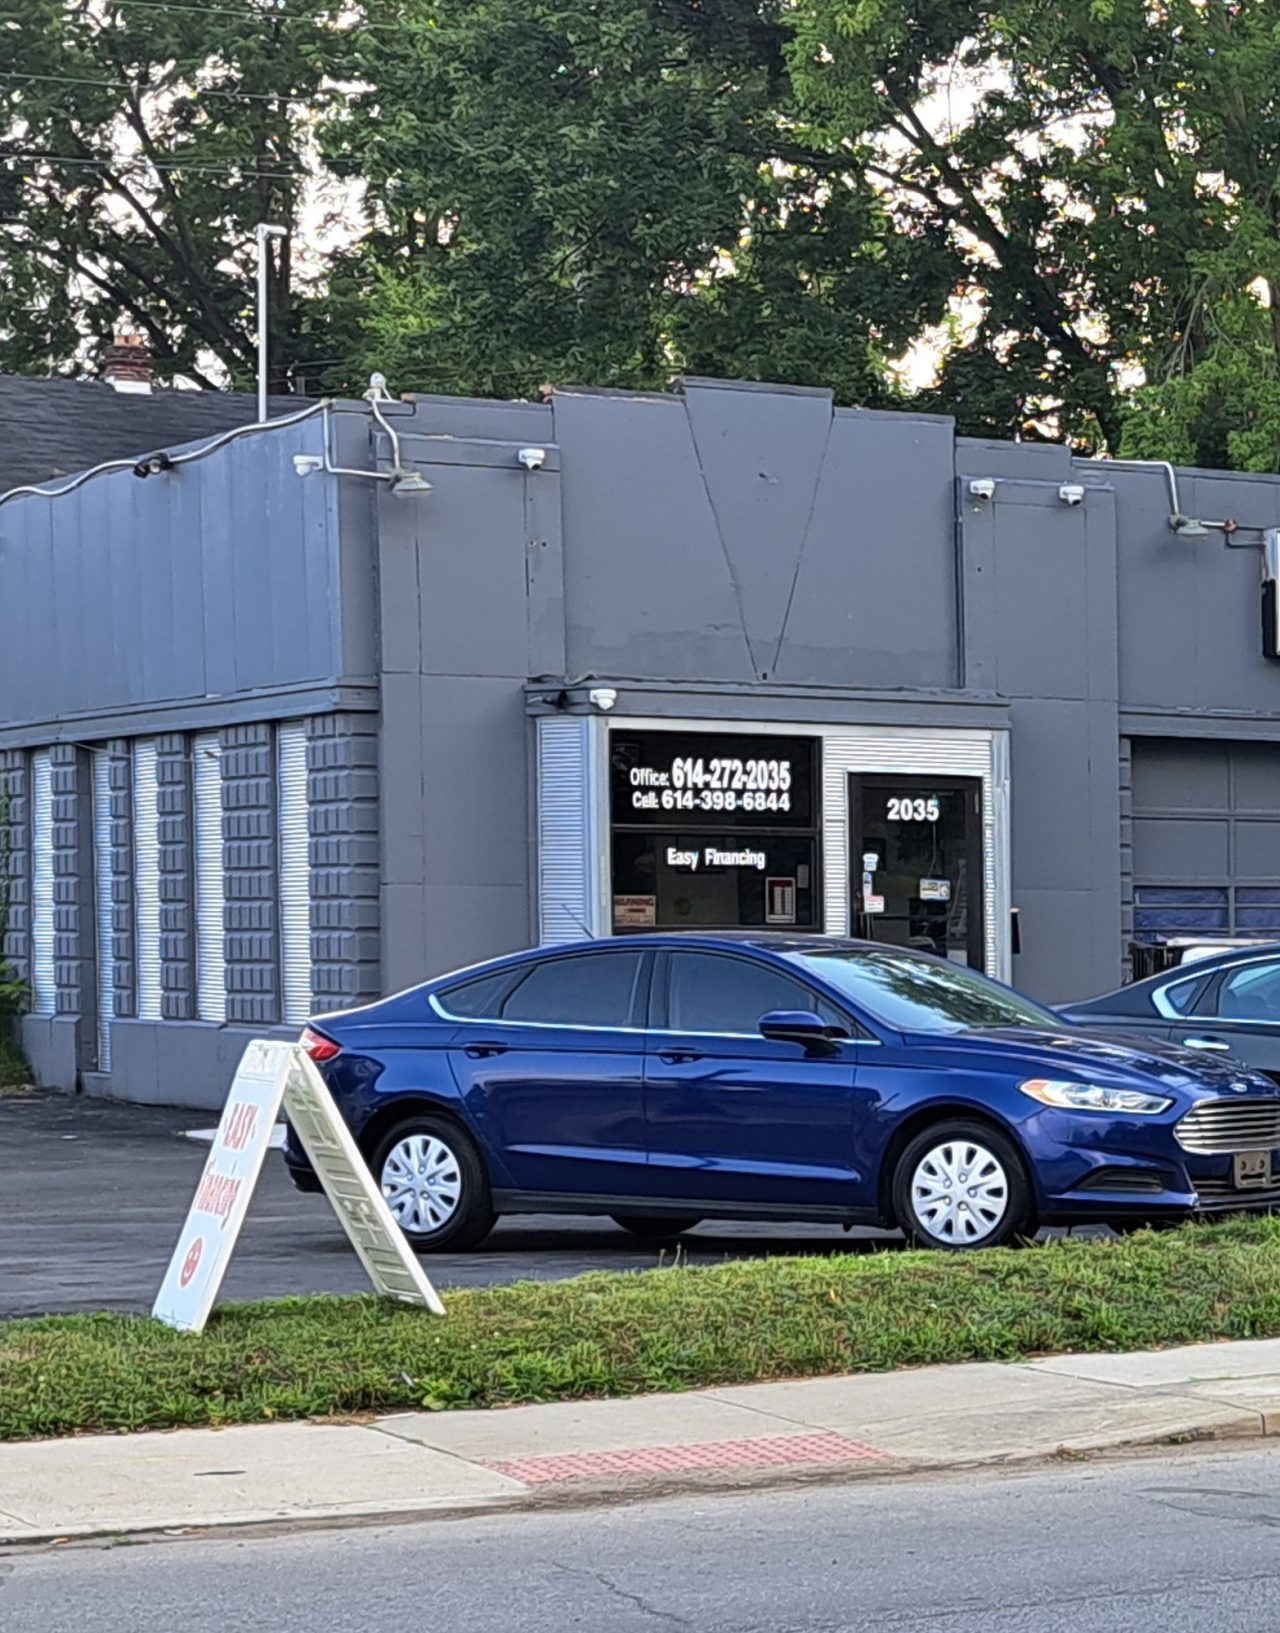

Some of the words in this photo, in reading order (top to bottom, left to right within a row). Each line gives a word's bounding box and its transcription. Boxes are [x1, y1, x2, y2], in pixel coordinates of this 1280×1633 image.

[630, 767, 670, 787] Office:
[672, 757, 791, 791] 614-272-2035
[632, 791, 660, 809] Cell:
[661, 789, 791, 812] 614-398-6844
[886, 797, 940, 822] 2035
[667, 847, 699, 871] Easy
[705, 847, 766, 870] Financing
